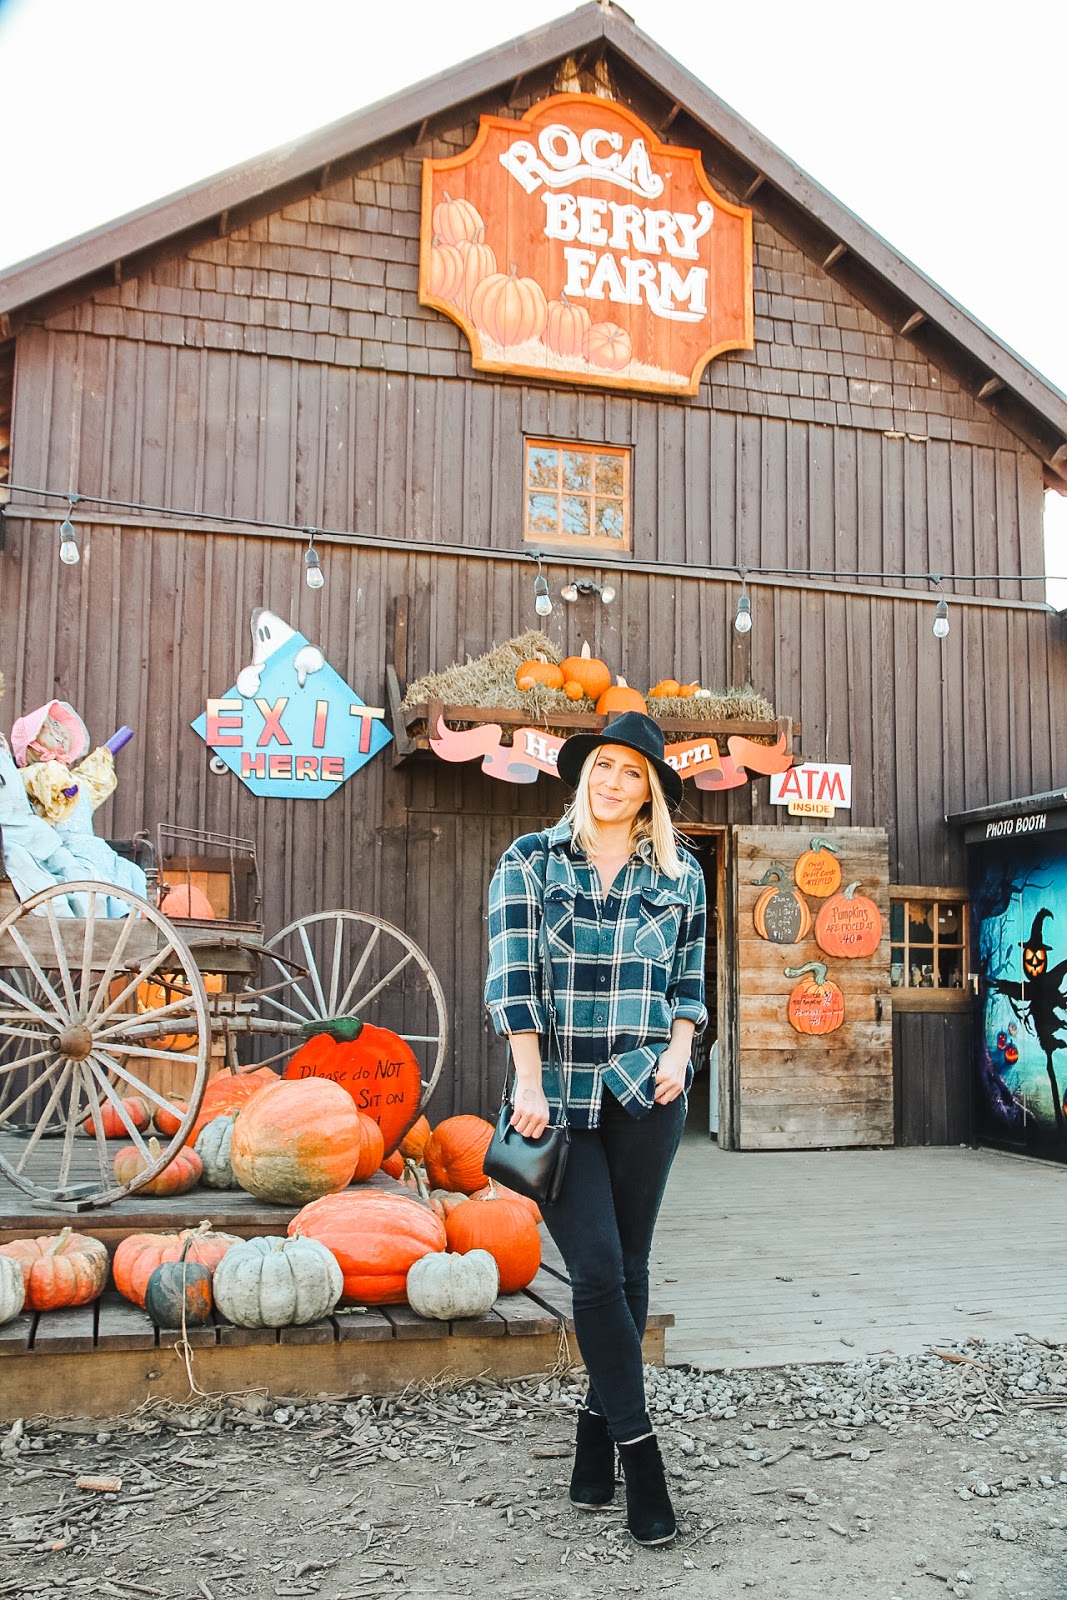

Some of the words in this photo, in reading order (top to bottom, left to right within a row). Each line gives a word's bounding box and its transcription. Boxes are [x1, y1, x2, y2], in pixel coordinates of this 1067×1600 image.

[499, 124, 664, 199] ROCA
[541, 191, 714, 260] BERRY
[563, 247, 708, 322] FARM
[205, 697, 386, 754] EXIT
[240, 752, 345, 782] HERE
[524, 731, 559, 766] Ha
[663, 743, 713, 771] arn
[778, 768, 846, 801] ATM
[792, 803, 830, 813] INSIDE
[986, 819, 1014, 838] PHOTO
[1015, 813, 1047, 834] BOOTH
[831, 907, 869, 923] Pumpkins
[352, 1066, 370, 1080] do
[374, 1059, 406, 1080] NOT
